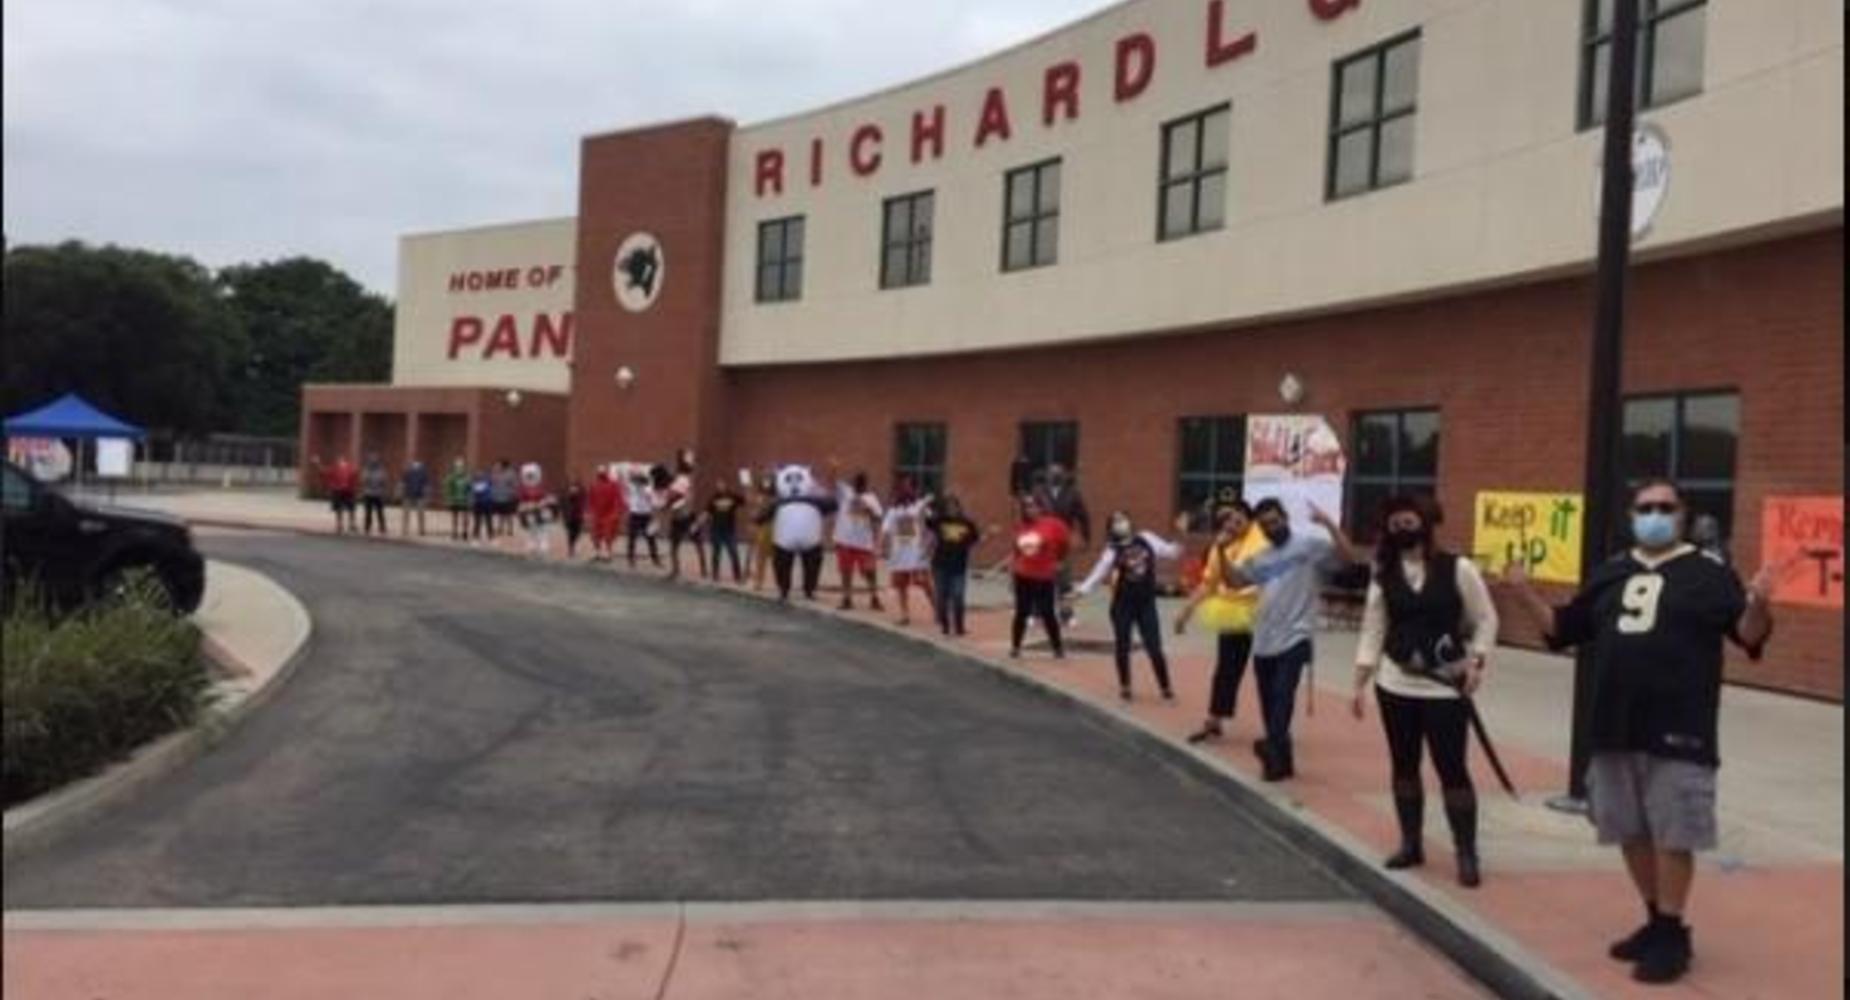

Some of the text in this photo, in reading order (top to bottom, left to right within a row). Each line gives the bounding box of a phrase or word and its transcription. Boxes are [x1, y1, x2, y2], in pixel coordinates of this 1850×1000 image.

[754, 32, 1156, 198] RICHARD
[448, 265, 563, 292] HOME OF
[446, 312, 573, 359] PAN
[1482, 499, 1537, 539] Keep
[1617, 573, 1664, 633] 9
